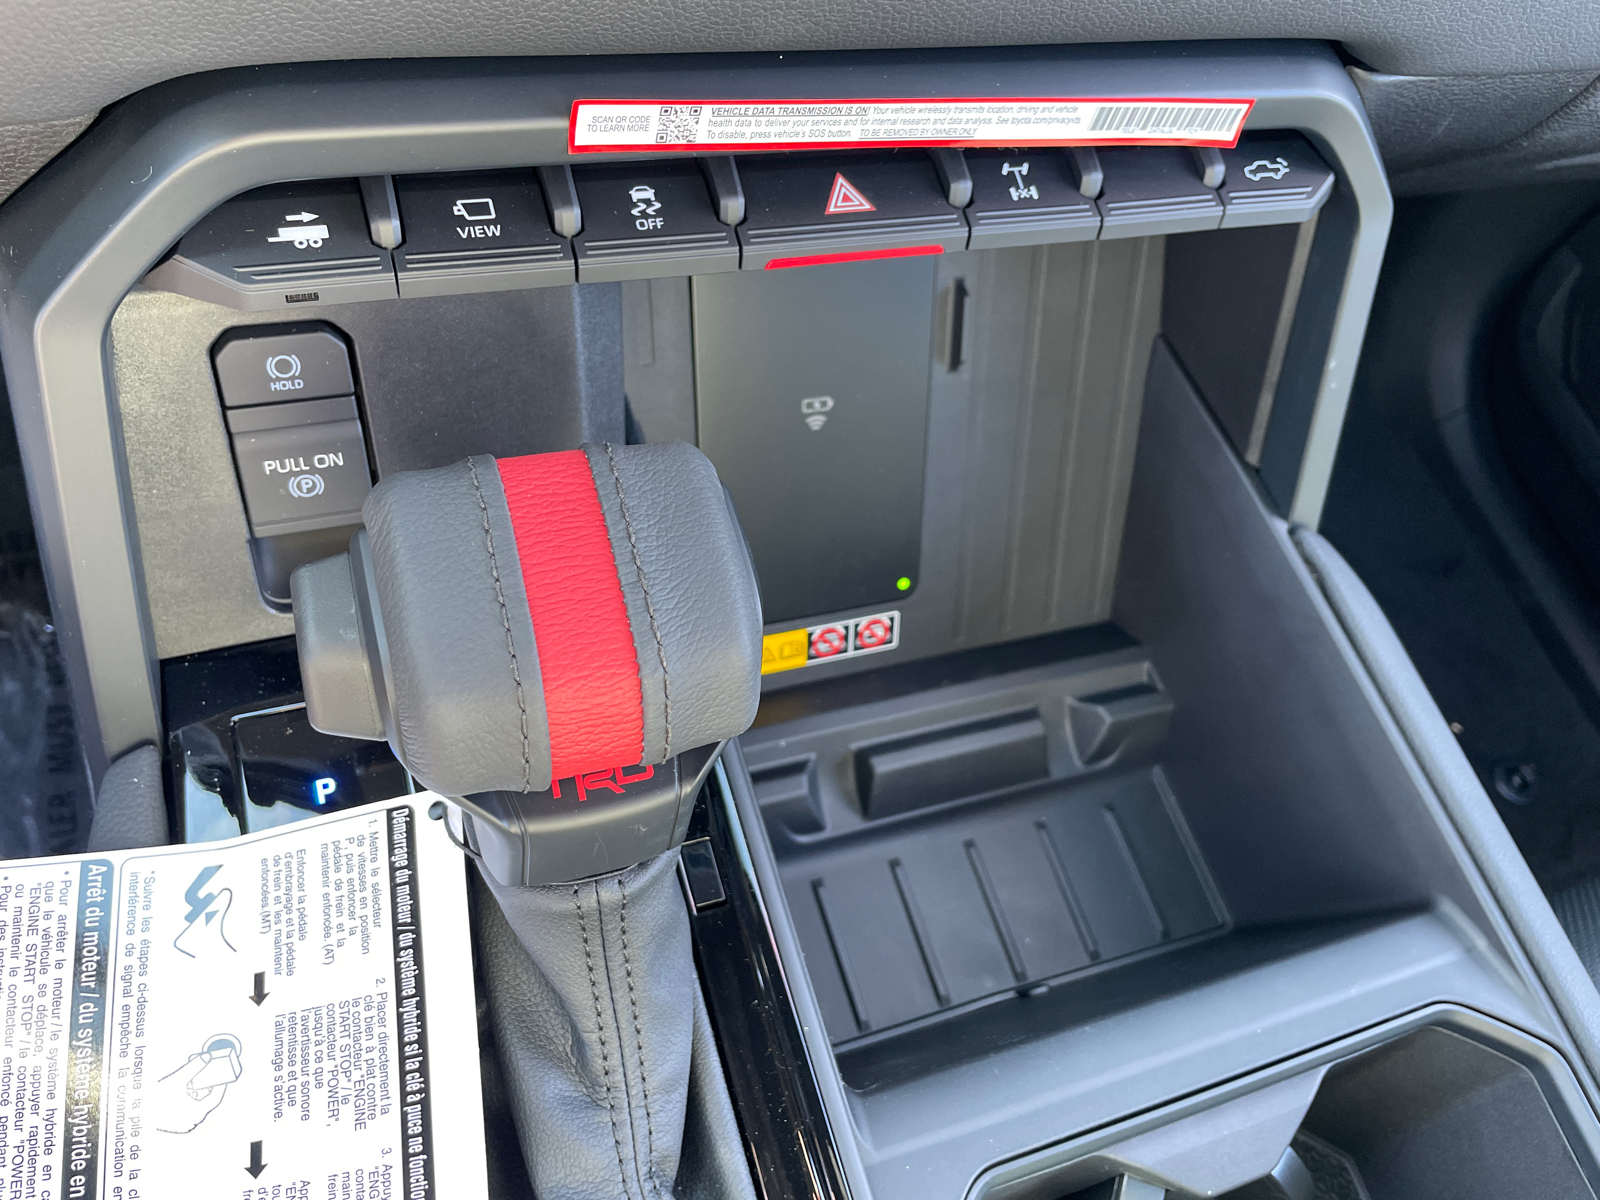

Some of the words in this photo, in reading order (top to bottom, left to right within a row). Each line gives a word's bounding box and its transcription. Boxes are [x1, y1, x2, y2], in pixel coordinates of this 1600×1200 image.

[587, 124, 598, 132] TO
[599, 124, 625, 132] LEARN
[627, 124, 650, 132] MORE
[591, 116, 613, 124] SCAN
[708, 119, 732, 127] health
[735, 119, 752, 127] data
[754, 119, 762, 127] to
[765, 118, 790, 127] deliver
[792, 119, 809, 129] your
[811, 118, 842, 127] services
[843, 117, 858, 126] and
[859, 117, 870, 126] for
[871, 117, 899, 126] internal
[900, 117, 930, 126] research
[932, 117, 946, 125] and
[947, 117, 963, 125] data
[995, 116, 1010, 125] See
[711, 106, 750, 116] VEHICLE
[752, 106, 775, 116] DATA
[778, 106, 843, 115] TRANSMISSION
[844, 106, 855, 115] IS
[855, 106, 871, 115] ON!
[873, 106, 889, 114] Your
[891, 106, 915, 114] vehicle
[919, 105, 953, 115] wirelessly
[953, 105, 985, 114] transmits
[1016, 105, 1039, 115] driving
[1040, 105, 1055, 114] and
[1055, 105, 1079, 113] vehicle
[707, 130, 716, 139] To
[718, 129, 748, 140] disable,
[750, 130, 771, 140] press
[773, 129, 806, 138] vehicle's
[808, 129, 826, 138] SOS
[827, 128, 852, 137] button.
[860, 129, 871, 137] TO
[882, 128, 920, 136] REMOVED
[919, 128, 931, 136] BY
[931, 128, 958, 136] OWNER
[958, 127, 978, 135] ONLY
[456, 224, 501, 239] VIEW
[635, 217, 664, 231] OFF
[270, 379, 304, 392] HOLD
[263, 456, 310, 475] PULL
[313, 452, 344, 469] ON
[301, 478, 313, 493] P
[314, 777, 338, 805] P
[357, 834, 367, 847] de
[369, 831, 379, 863] Mettre
[390, 808, 410, 868] Démarrage
[297, 849, 306, 892] Enfoncer
[321, 843, 331, 888] maintenir
[331, 840, 343, 874] pédale
[343, 853, 356, 873] puis
[358, 852, 368, 892] vitesses
[43, 881, 54, 903] que
[59, 880, 72, 906] Pour
[86, 865, 108, 903] Arrêt
[142, 876, 155, 911] Suivre
[274, 870, 282, 891] frein
[284, 852, 294, 915] d'embrayage
[395, 869, 412, 883] du
[0, 886, 12, 912] Pour
[27, 883, 41, 937] "ENGINE
[126, 872, 141, 936] interférence
[259, 858, 271, 934] enfoncées.(MT)
[298, 895, 307, 905] la
[335, 895, 344, 917] frein
[347, 878, 358, 921] enfoncer
[360, 897, 368, 910] en
[372, 882, 382, 928] sélecteur
[396, 885, 413, 923] moteur
[10, 906, 23, 960] maintenir
[43, 910, 54, 921] le
[55, 914, 68, 953] arrêter
[141, 917, 153, 933] les
[274, 910, 283, 925] les
[296, 907, 308, 941] pédale
[322, 892, 333, 941] enfoncée.
[348, 926, 358, 936] la
[39, 927, 53, 975] véhicule
[274, 929, 284, 976] maintenir
[359, 915, 371, 955] position
[399, 933, 416, 947] du
[24, 943, 37, 984] START
[55, 959, 67, 970] le
[81, 932, 101, 988] moteur
[137, 939, 152, 976] étapes
[282, 942, 296, 976] pédale
[322, 944, 335, 965] (AT)
[397, 949, 418, 996] système
[38, 984, 48, 998] se
[51, 978, 63, 1020] moteur
[121, 965, 135, 998] signal
[4, 984, 18, 1048] contacteur
[21, 995, 34, 1036] STOP"
[136, 983, 149, 1037] ci-dessus
[338, 1000, 350, 1039] START
[352, 997, 362, 1008] le
[363, 995, 375, 1012] clé
[376, 992, 388, 1028] Placer
[399, 997, 423, 1042] hybride
[32, 1005, 48, 1056] déplace,
[118, 1004, 133, 1058] empêche
[271, 1014, 285, 1072] l'allumage
[288, 1012, 298, 1067] retentisse
[301, 1008, 312, 1077] l'avertisseur
[312, 1005, 325, 1047] jusqu'à
[326, 1003, 337, 1061] contacteur
[352, 1011, 363, 1071] contacteur
[364, 1016, 375, 1041] bien
[73, 1029, 96, 1099] système
[130, 1046, 146, 1089] lorsque
[339, 1044, 352, 1082] STOP"
[379, 1031, 390, 1101] directement
[404, 1044, 423, 1054] si
[405, 1057, 423, 1071] la
[0, 1057, 14, 1107] enfoncé
[46, 1048, 59, 1100] système
[312, 1067, 324, 1089] que
[364, 1058, 377, 1079] plat
[405, 1072, 425, 1090] clé
[14, 1066, 27, 1132] contacteur
[28, 1066, 42, 1116] appuyer
[274, 1075, 285, 1122] s'active.
[285, 1085, 297, 1107] que
[301, 1081, 310, 1121] sonore
[341, 1094, 352, 1105] le
[354, 1075, 366, 1131] "ENGINE
[366, 1082, 378, 1120] contre
[43, 1108, 57, 1156] hybride
[68, 1104, 93, 1171] hybride
[114, 1085, 127, 1178] communication
[129, 1116, 142, 1137] pile
[403, 1104, 422, 1134] puce
[25, 1126, 40, 1199] rapidement
[130, 1145, 141, 1160] de
[42, 1165, 52, 1181] en
[129, 1169, 141, 1180] la
[409, 1155, 428, 1200] fonctio
